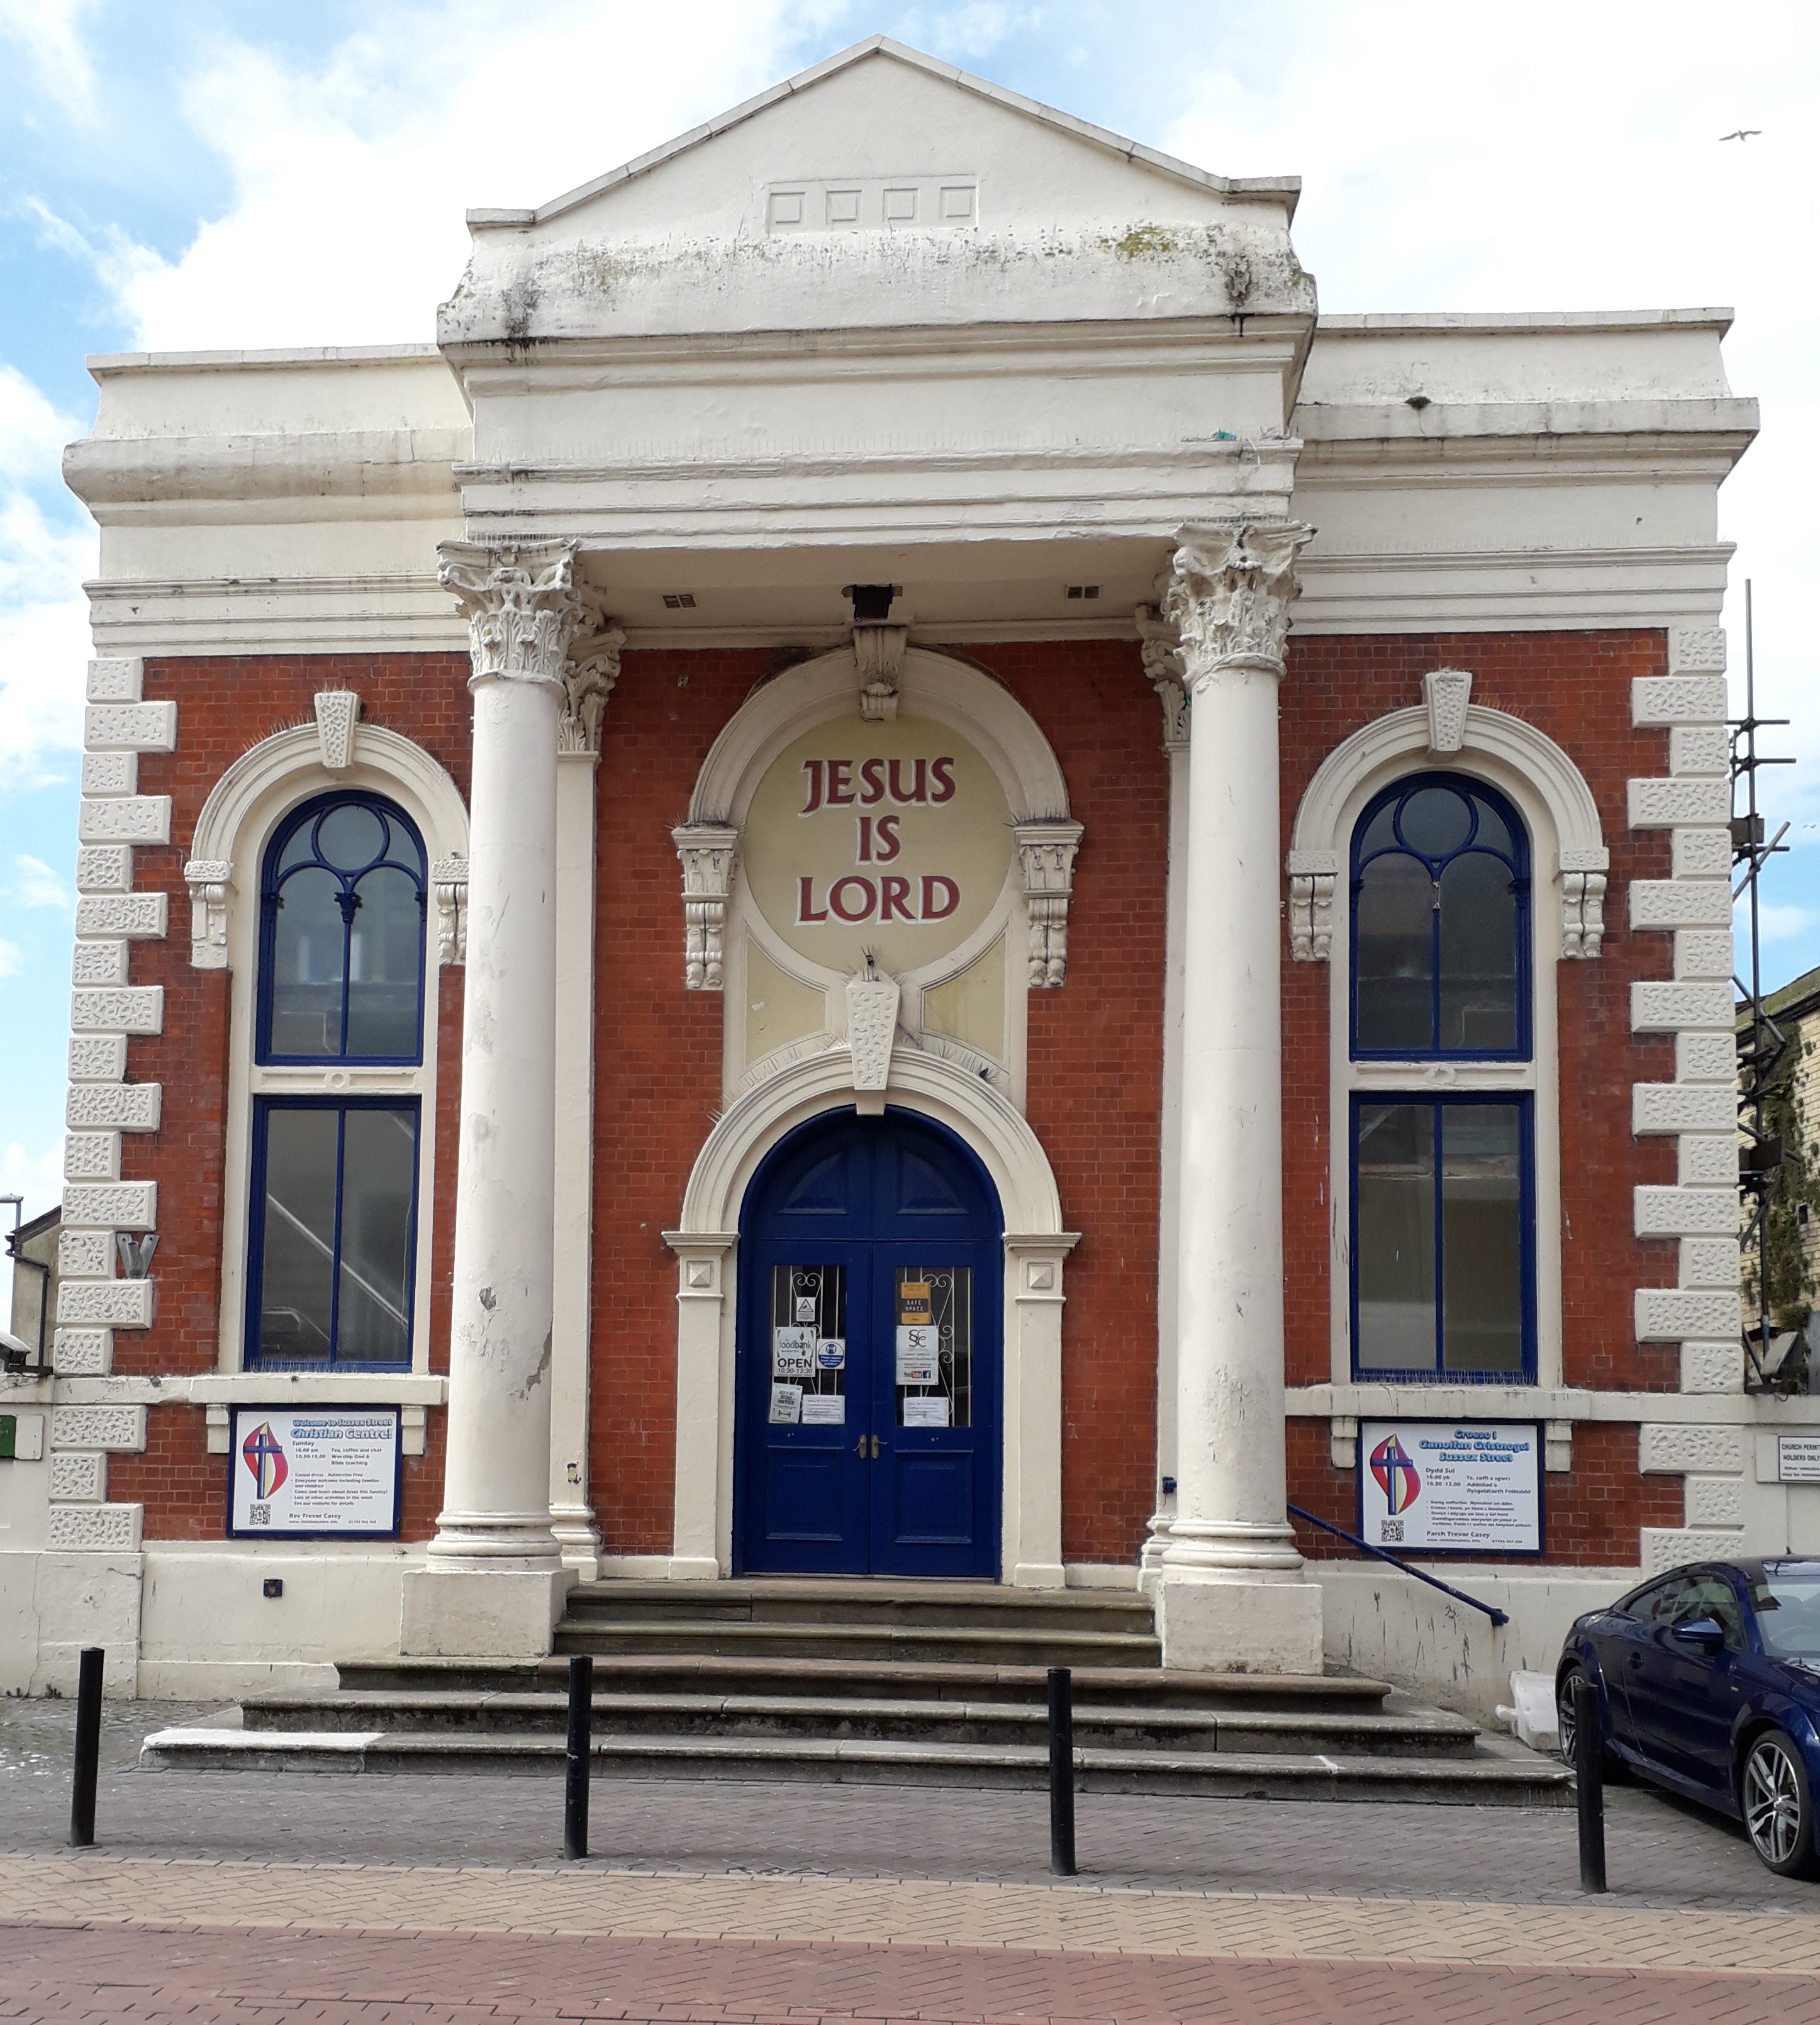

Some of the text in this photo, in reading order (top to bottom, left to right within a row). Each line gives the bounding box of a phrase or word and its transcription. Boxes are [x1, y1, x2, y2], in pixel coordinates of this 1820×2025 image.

[798, 756, 956, 817] JESUS
[855, 815, 902, 866] IS
[794, 875, 961, 926] LORD
[780, 1339, 812, 1349] foodbank
[778, 1358, 812, 1368] OPEN
[366, 1419, 393, 1427] Street
[291, 1428, 393, 1439] Christian Centre!
[1454, 1429, 1491, 1439] Croeso
[1439, 1451, 1514, 1462] Sussex Street
